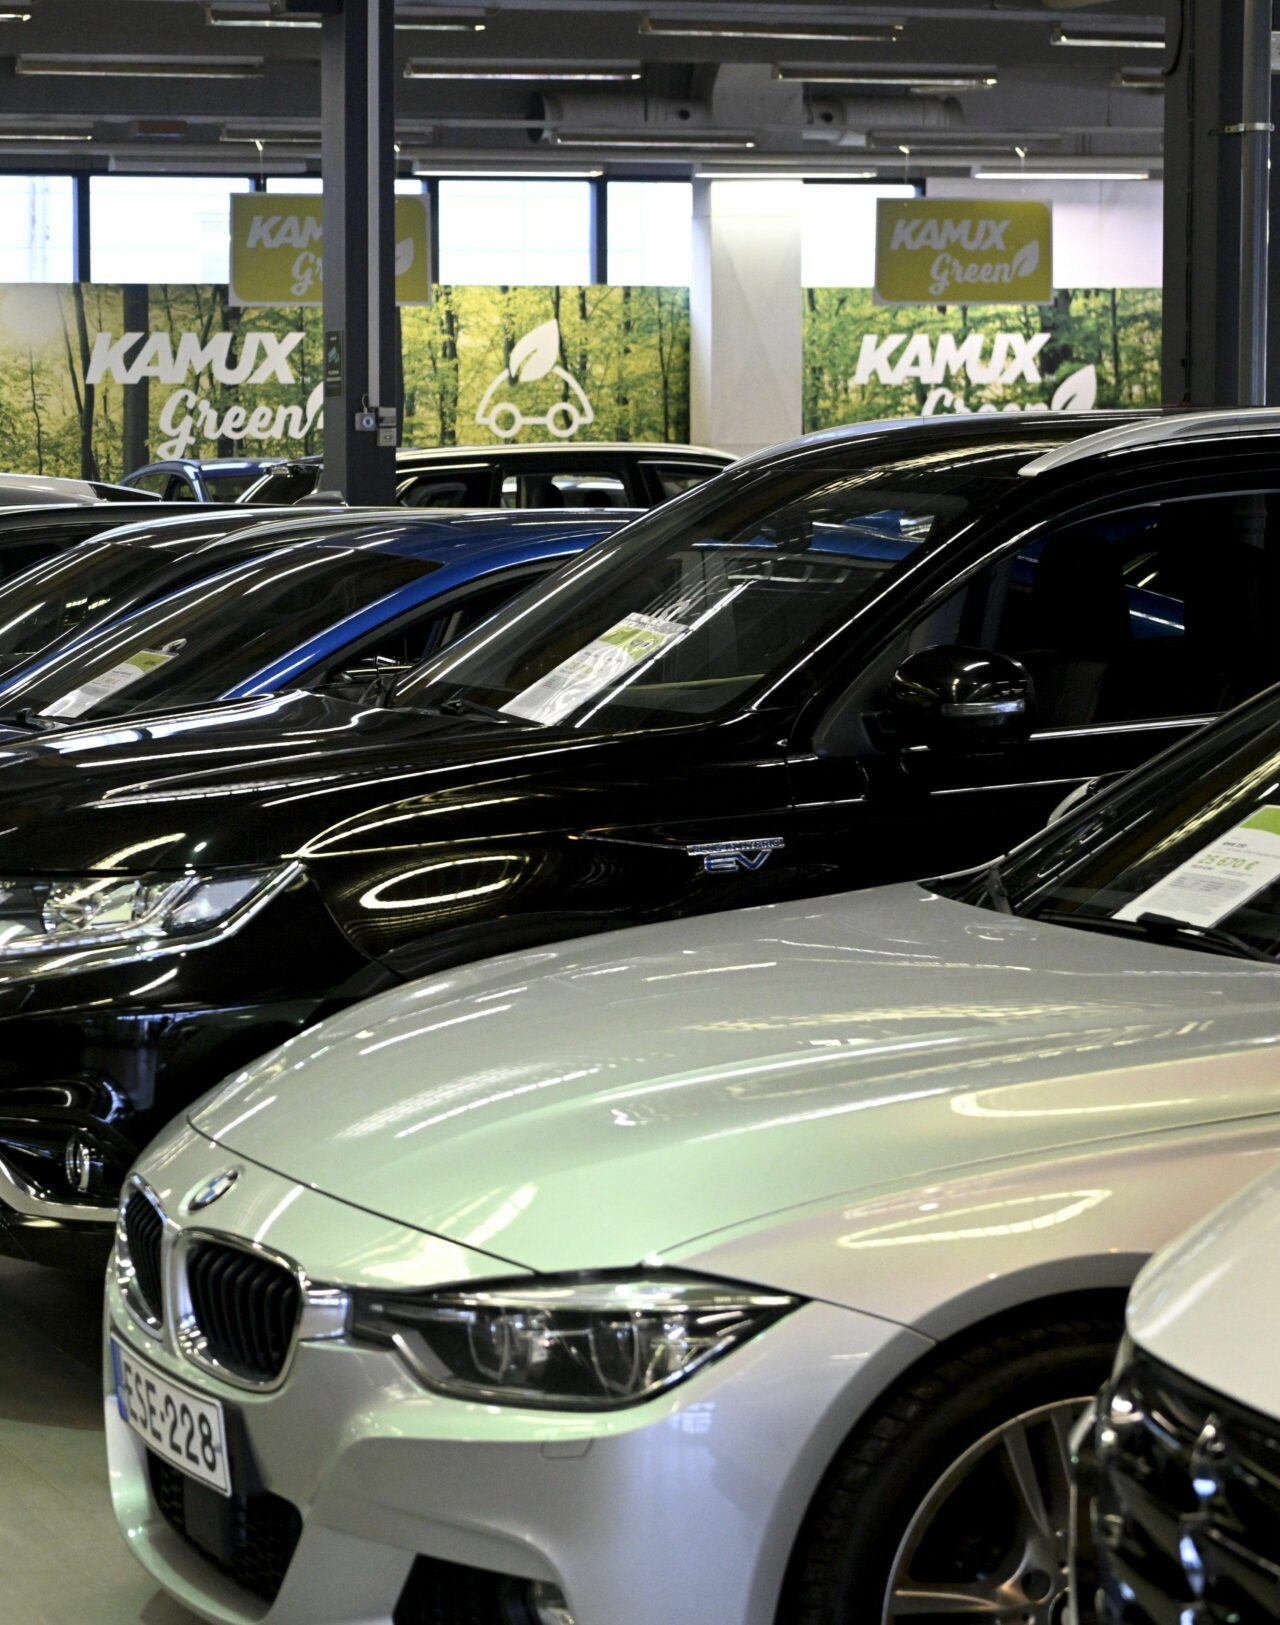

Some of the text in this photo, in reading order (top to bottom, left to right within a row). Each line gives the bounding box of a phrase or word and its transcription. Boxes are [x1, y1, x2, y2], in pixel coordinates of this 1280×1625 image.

[245, 215, 323, 248] KAM
[890, 219, 1011, 251] KAMUX
[928, 254, 1015, 296] Green
[86, 332, 306, 385] KAMUX
[855, 333, 1051, 385] KAMUX
[156, 389, 311, 460] Green
[704, 849, 772, 874] EV
[123, 1361, 217, 1473] ESE-228
